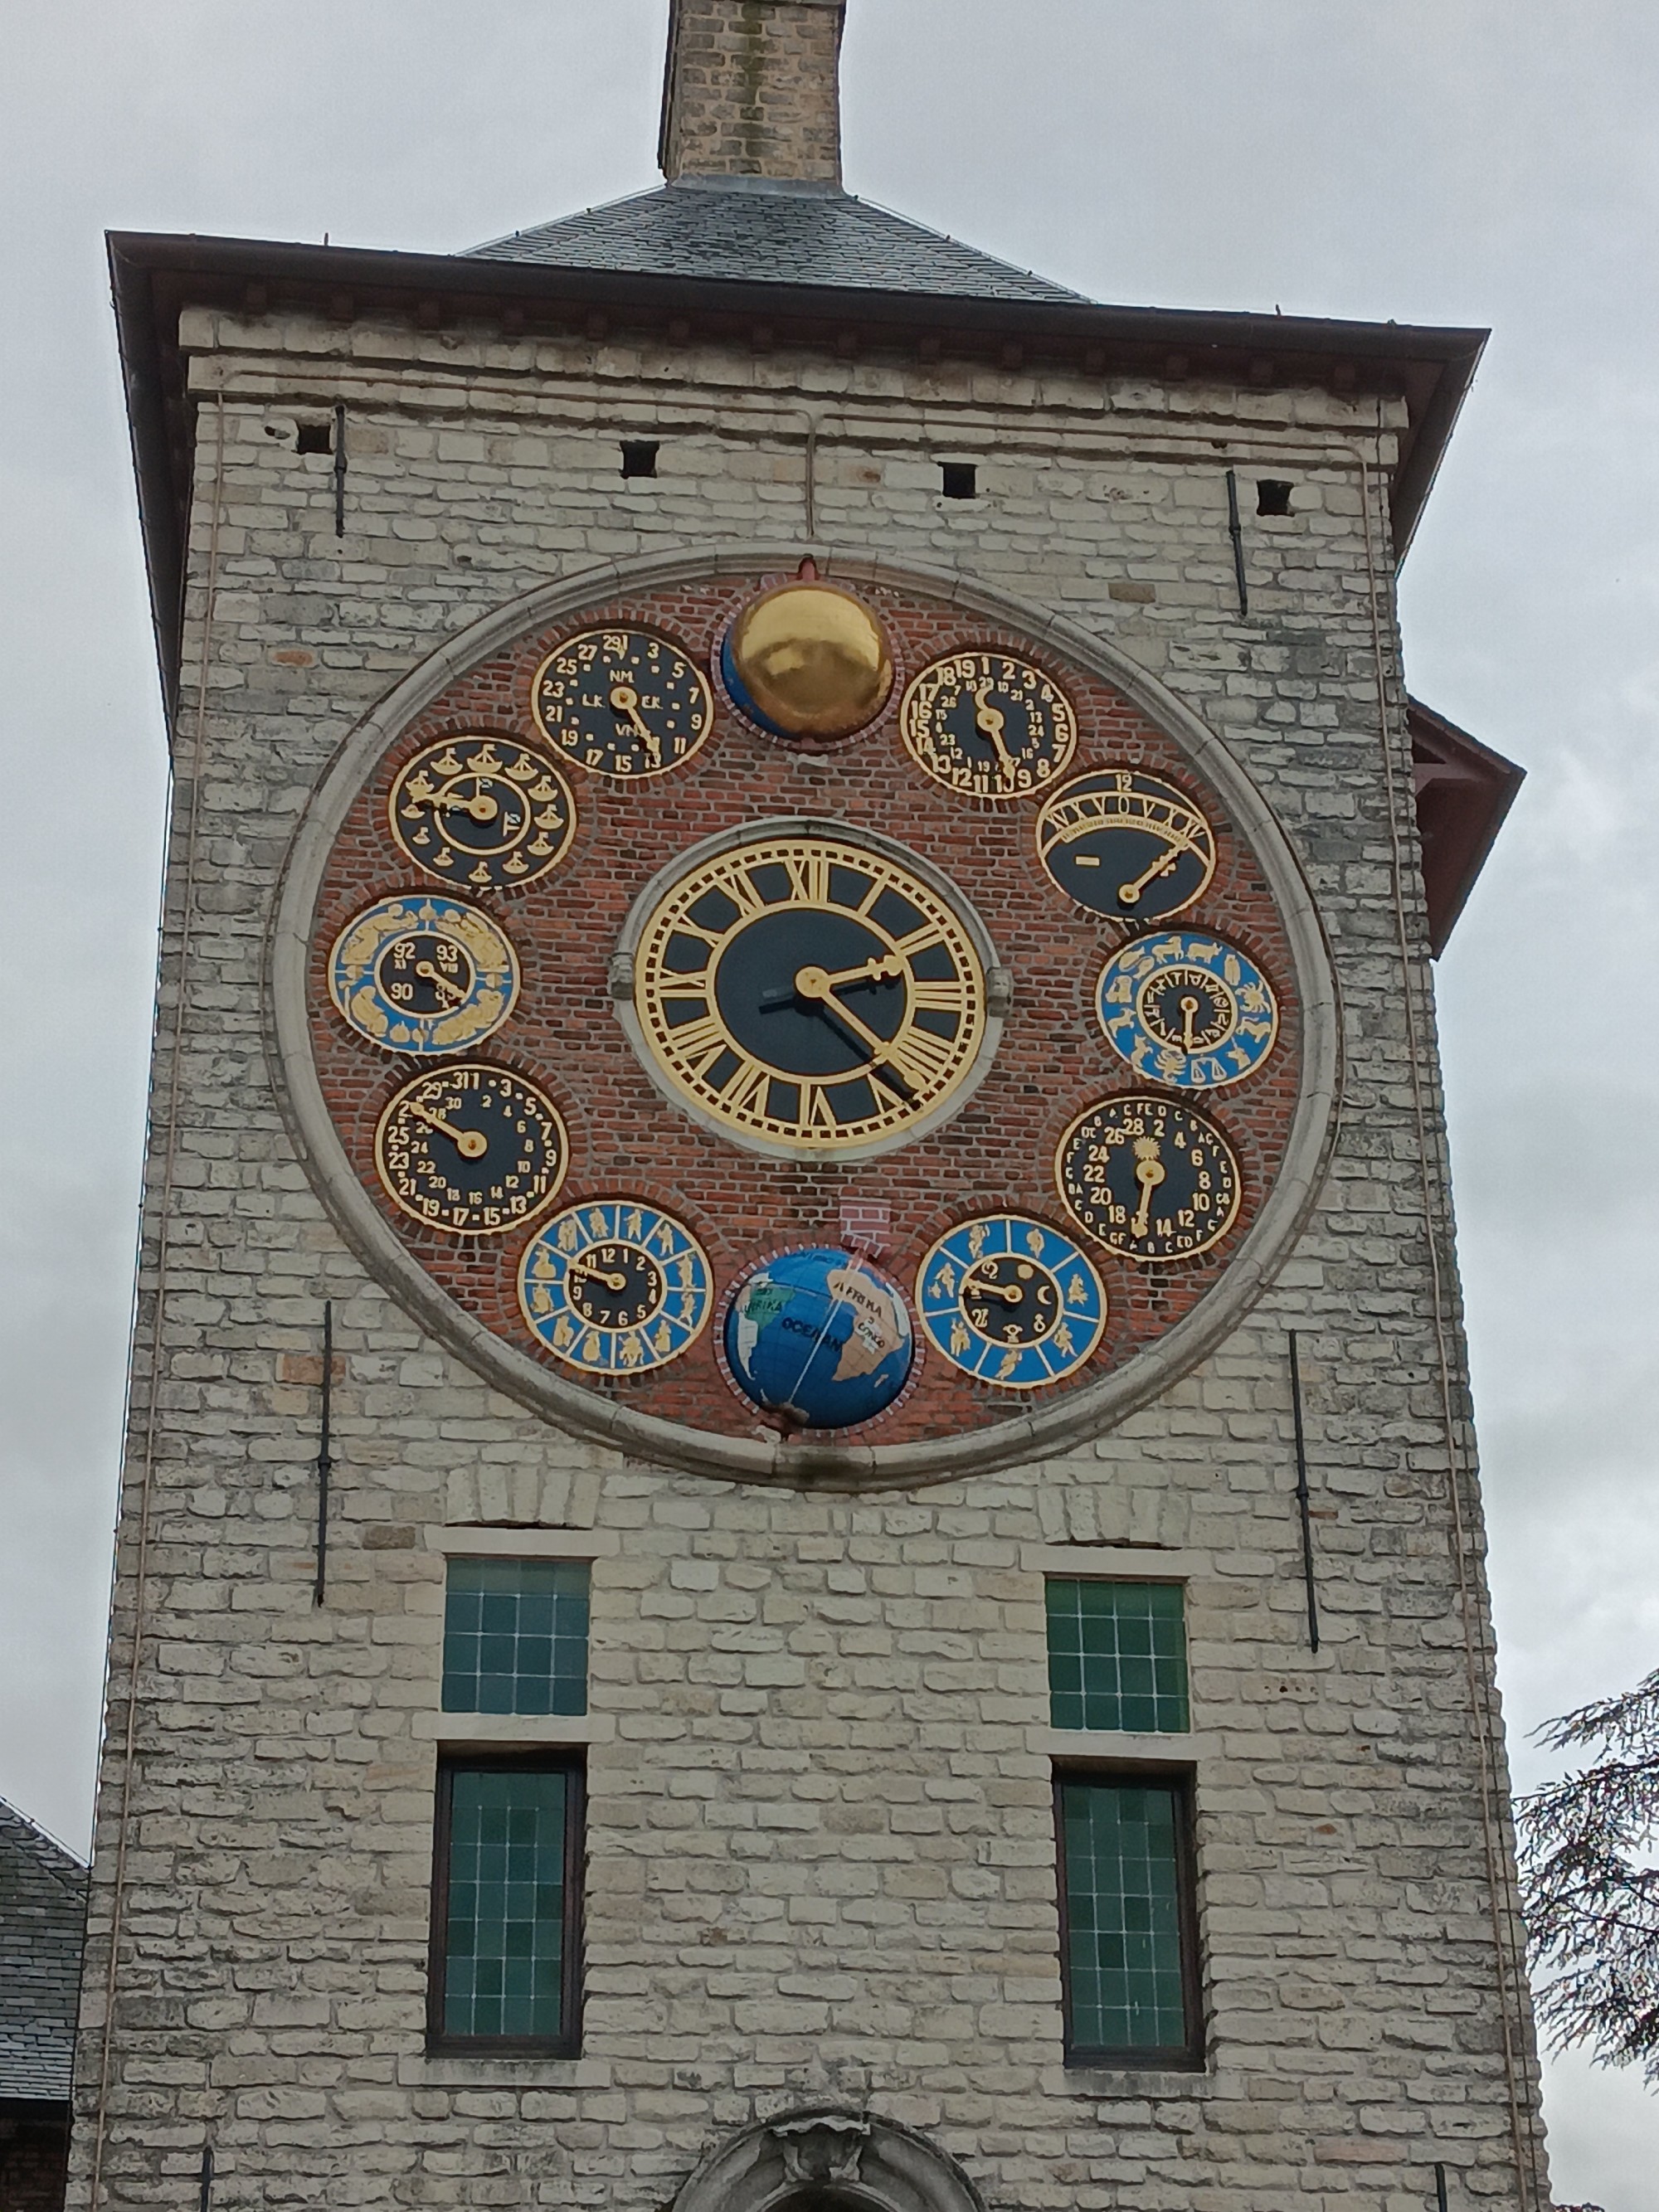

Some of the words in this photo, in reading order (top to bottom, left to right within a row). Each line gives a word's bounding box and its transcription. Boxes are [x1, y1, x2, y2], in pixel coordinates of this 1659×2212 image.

[603, 635, 621, 650] 29
[648, 643, 659, 659] 3
[578, 644, 597, 660] 27
[557, 658, 577, 675] 25
[672, 662, 686, 678] 5
[954, 659, 975, 678] 19
[981, 657, 989, 674] 1
[1003, 662, 1015, 679] 2
[610, 670, 634, 683] NM
[937, 667, 956, 685] 18
[1022, 670, 1036, 688] 3
[543, 680, 565, 698] 23
[689, 688, 699, 703] 7
[919, 683, 940, 702] 17
[954, 685, 961, 696] 7
[998, 682, 1009, 693] 10
[1011, 690, 1022, 701] 21
[1041, 684, 1053, 702] 4
[912, 701, 932, 719] 16
[941, 696, 956, 707] 26
[1025, 699, 1034, 710] 2
[546, 706, 562, 722] 21
[1030, 712, 1042, 723] 13
[1052, 703, 1065, 722] 5
[691, 713, 702, 730] 9
[910, 719, 929, 737] 15
[562, 729, 577, 746] 19
[1029, 725, 1044, 737] 24
[1055, 723, 1068, 741] 6
[674, 737, 686, 754] 11
[917, 737, 936, 756] 14
[940, 735, 955, 746] 23
[586, 749, 603, 766] 17
[951, 747, 962, 760] 12
[1022, 748, 1033, 759] 16
[1052, 744, 1066, 762] 7
[615, 756, 631, 772] 15
[932, 755, 951, 773] 13
[967, 757, 971, 768] 1
[978, 761, 990, 772] 19
[1037, 759, 1050, 777] 8
[953, 768, 972, 786] 12
[974, 775, 988, 793] 11
[995, 775, 1014, 792] 10
[1018, 770, 1031, 787] 9
[1116, 775, 1131, 791] 12
[783, 858, 830, 904] XII
[710, 867, 766, 918] XI
[856, 873, 889, 916] I
[673, 915, 726, 949] X
[893, 921, 945, 957] II
[393, 942, 416, 959] 92
[436, 945, 458, 962] 93
[391, 983, 413, 1000] 90
[659, 968, 707, 998] IX
[912, 980, 962, 1011] III
[451, 1072, 469, 1089] 31
[470, 1072, 479, 1089] 1
[500, 1079, 512, 1097] 3
[422, 1082, 442, 1100] 29
[721, 1063, 771, 1119] VII
[868, 1073, 906, 1116] V
[445, 1097, 462, 1109] 30
[482, 1095, 491, 1107] 2
[524, 1097, 536, 1115] 5
[800, 1083, 838, 1126] VI
[504, 1106, 512, 1117] 4
[388, 1126, 410, 1144] 25
[518, 1121, 526, 1133] 6
[542, 1122, 552, 1140] 7
[1104, 1126, 1125, 1145] 26
[1123, 1119, 1144, 1135] 28
[1154, 1120, 1165, 1137] 2
[411, 1142, 428, 1153] 24
[524, 1140, 533, 1152] 8
[1175, 1131, 1186, 1149] 4
[388, 1152, 409, 1169] 23
[546, 1150, 557, 1166] 9
[1088, 1145, 1110, 1163] 24
[1191, 1150, 1203, 1166] 6
[416, 1161, 436, 1174] 22
[518, 1161, 530, 1173] 10
[1083, 1164, 1105, 1183] 22
[399, 1179, 416, 1195] 21
[429, 1176, 446, 1188] 20
[506, 1176, 519, 1188] 12
[533, 1175, 546, 1194] 11
[1199, 1171, 1211, 1189] 8
[469, 1193, 482, 1204] 16
[510, 1196, 527, 1213] 13
[1090, 1187, 1112, 1205] 20
[1193, 1193, 1209, 1211] 10
[423, 1198, 440, 1216] 19
[1108, 1206, 1126, 1223] 18
[453, 1208, 469, 1226] 17
[484, 1208, 500, 1225] 15
[1178, 1209, 1194, 1228] 12
[1156, 1219, 1176, 1237] 14
[586, 1254, 596, 1268] 11
[601, 1248, 615, 1262] 12
[624, 1249, 628, 1263] 1
[636, 1257, 645, 1271] 2
[648, 1271, 657, 1286] 3
[573, 1286, 581, 1300] 9
[649, 1289, 656, 1304] 4
[582, 1303, 592, 1317] 8
[600, 1310, 611, 1324] 7
[618, 1312, 628, 1325] 6
[637, 1305, 646, 1320] 5
